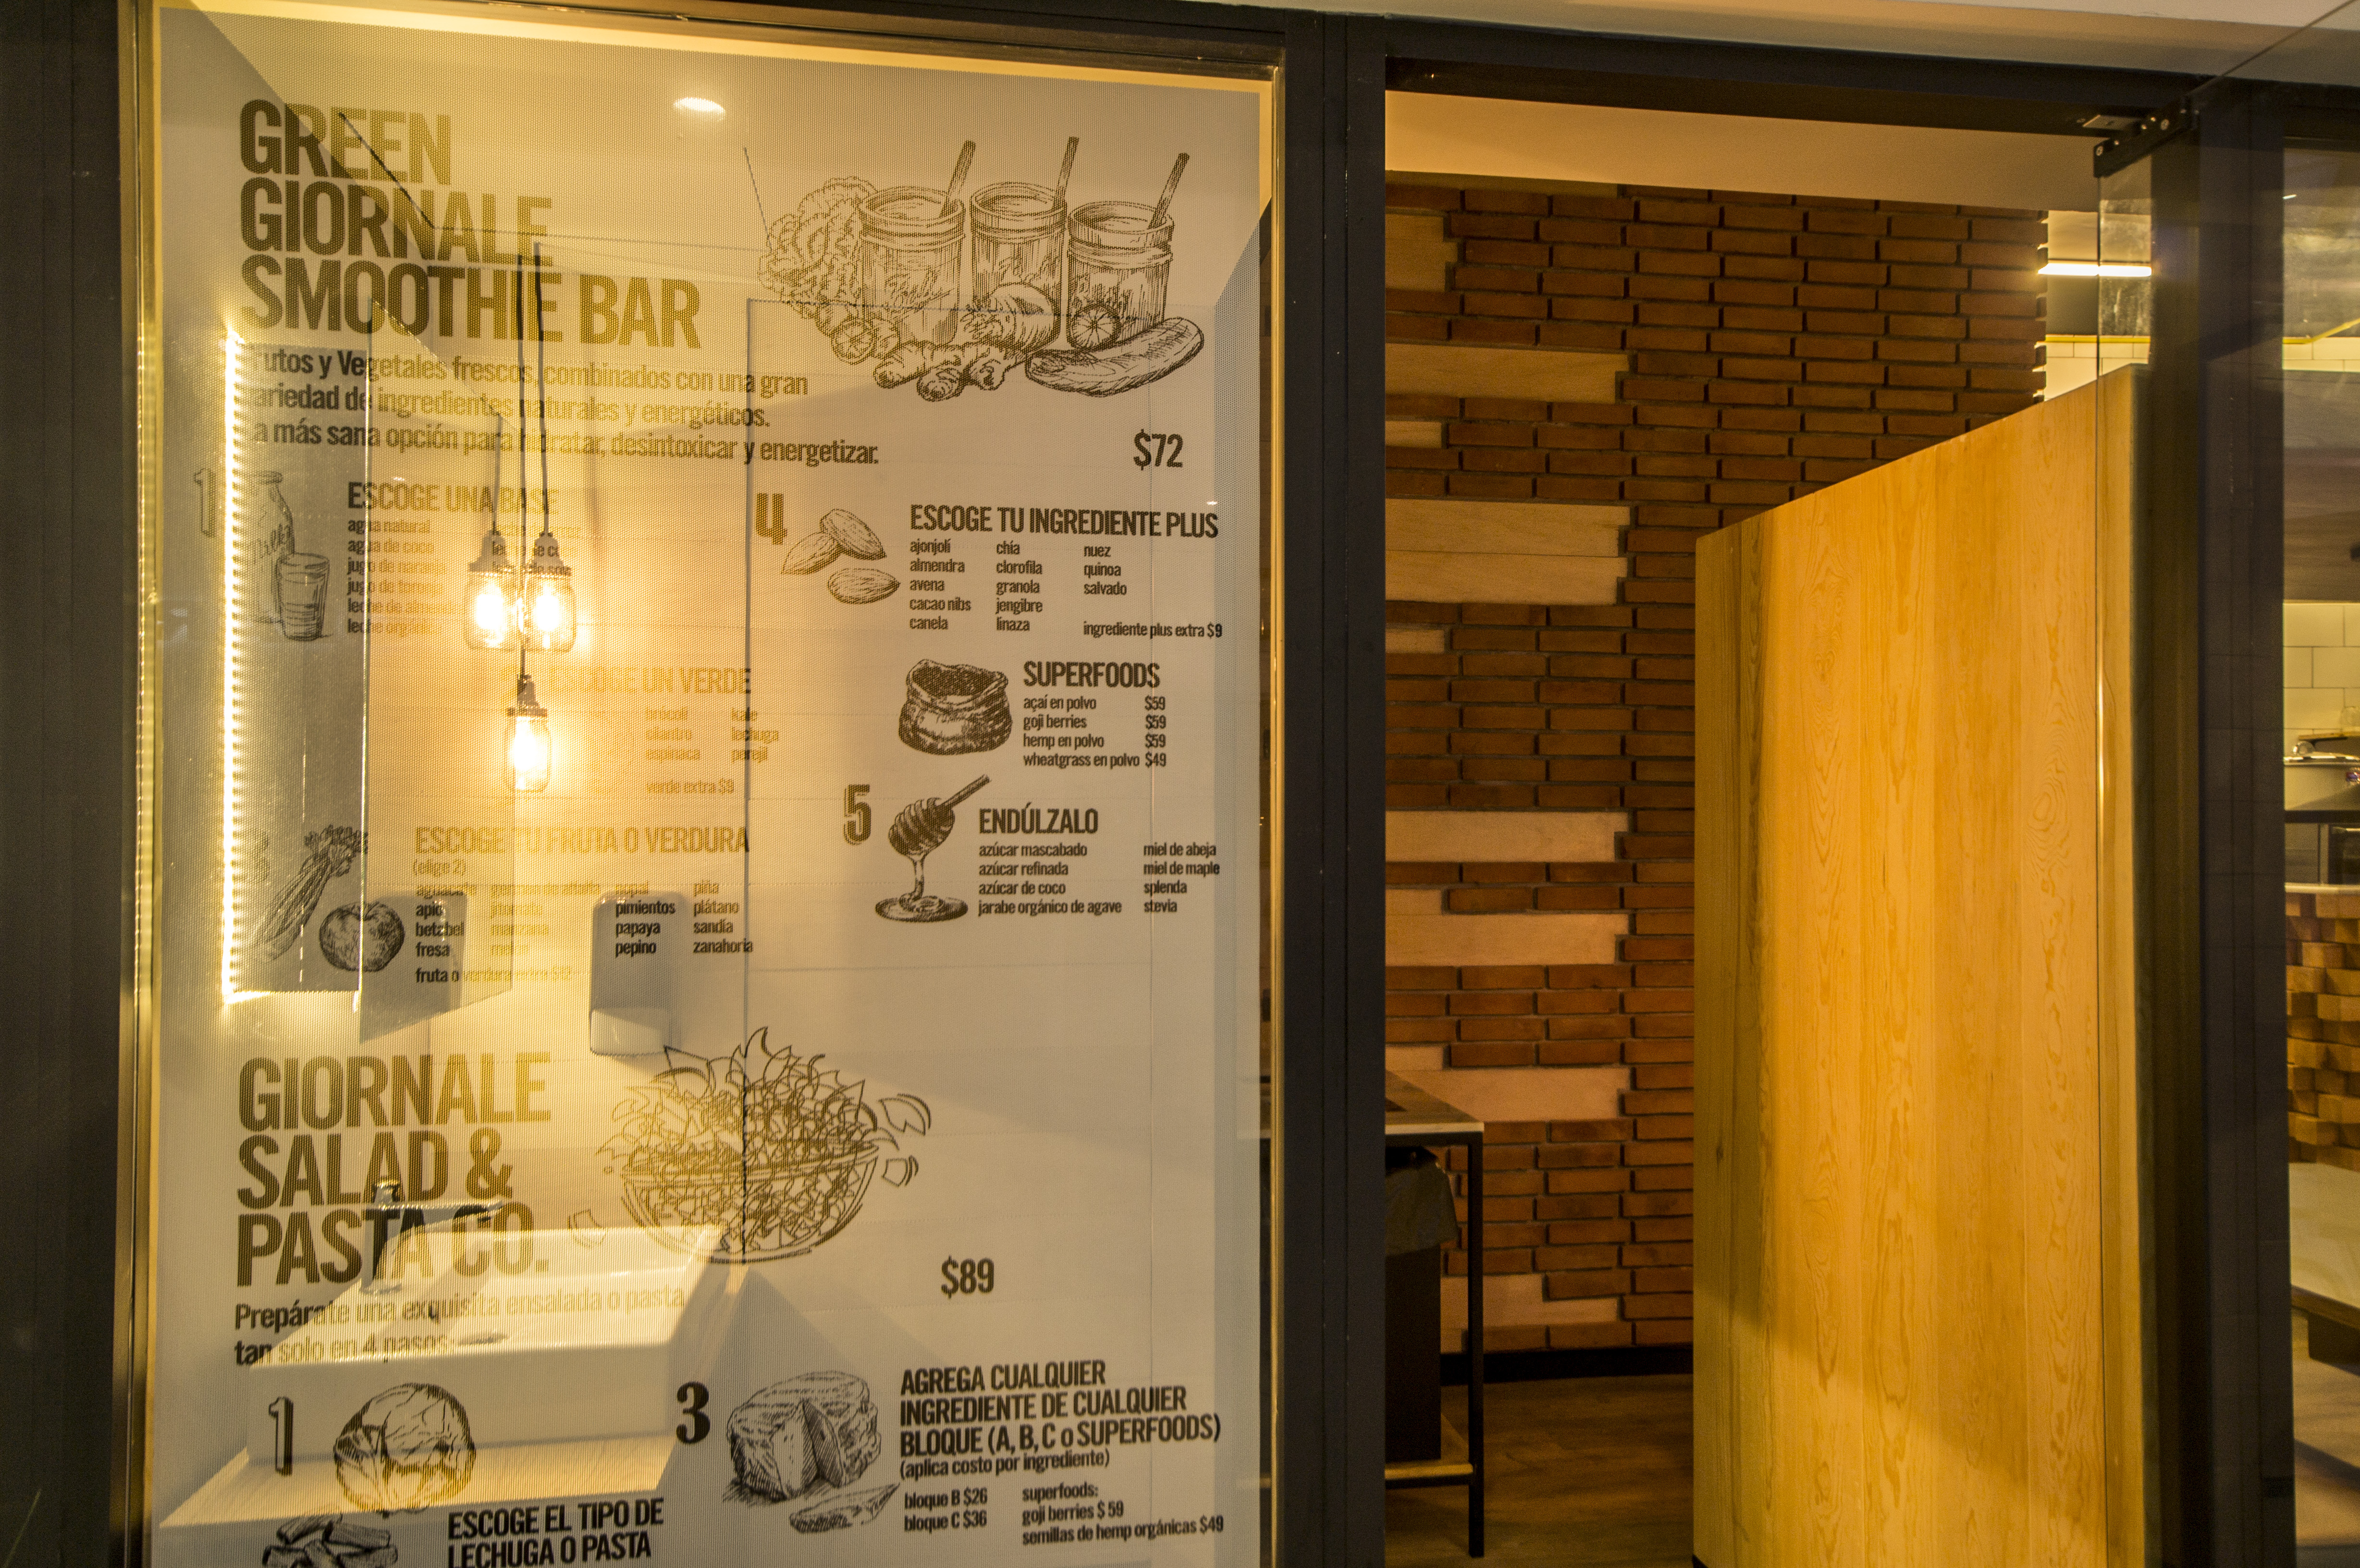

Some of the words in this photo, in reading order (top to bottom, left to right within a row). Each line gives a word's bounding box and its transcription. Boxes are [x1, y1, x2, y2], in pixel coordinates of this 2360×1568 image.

[240, 99, 451, 185] GREEN
[240, 177, 553, 267] GIORNALE
[241, 254, 563, 342] SMOOTHIE
[579, 273, 701, 349] BAR
[319, 355, 332, 380] y
[337, 350, 447, 382] Vegetales
[544, 362, 668, 390] combinados
[676, 371, 713, 392] con
[720, 374, 756, 393] una
[761, 375, 808, 399] gran
[345, 386, 372, 412] de
[378, 388, 513, 419] ingredientes
[273, 417, 321, 444] más
[327, 425, 381, 447] sana
[386, 423, 458, 453] opción
[464, 428, 513, 455] para
[611, 432, 738, 460] desintoxicar
[744, 440, 755, 466] y
[760, 439, 879, 467] energetizar.
[1133, 429, 1183, 471] $72
[193, 467, 217, 539] 1
[348, 482, 440, 512] ESCOGE
[445, 485, 494, 514] UNA
[500, 487, 559, 514] BASE
[756, 493, 787, 545] 4
[910, 504, 993, 532] ESCOGE
[997, 506, 1024, 533] TU
[1030, 508, 1162, 536] INGREDIENTE
[1166, 512, 1219, 539] PLUS
[910, 538, 951, 556] ajonjolí
[996, 540, 1020, 555] chía
[1084, 545, 1111, 557] nuez
[910, 558, 965, 573] almendra
[996, 560, 1043, 575] clorofila
[1084, 562, 1121, 579] quinoa
[910, 580, 945, 592] avena
[996, 579, 1040, 596] granola
[1084, 581, 1127, 596] salvado
[910, 599, 945, 611] cacao
[948, 597, 971, 611] nibs
[996, 597, 1043, 615] jengibre
[910, 615, 948, 630] canela
[996, 617, 1030, 632] linaza
[1083, 621, 1148, 638] ingrediente
[1150, 623, 1172, 640] plus
[1175, 624, 1205, 638] extra
[1207, 622, 1223, 638] $9
[642, 666, 674, 695] UN
[678, 667, 751, 695] VERDE
[1023, 660, 1161, 688] SUPERFOODS
[1023, 694, 1047, 712] açaí
[1050, 698, 1064, 710] en
[1067, 696, 1097, 712] polvo
[1145, 695, 1166, 711] $59
[1023, 714, 1044, 731] goji
[1046, 714, 1087, 729] berries
[1145, 713, 1167, 731] $59
[1023, 733, 1055, 749] hemp
[1058, 736, 1071, 747] en
[1074, 734, 1105, 750] polvo
[1145, 733, 1166, 749] $59
[1023, 752, 1091, 769] wheatgrass
[1094, 755, 1107, 767] en
[1110, 753, 1140, 770] polvo
[1145, 752, 1167, 768] $49
[843, 784, 872, 846] 5
[979, 802, 1099, 834] ENDÚLZALO
[415, 827, 506, 855] ESCOGE
[547, 826, 618, 854] FRUTA
[623, 826, 639, 854] O
[644, 826, 750, 854] VERDURA
[979, 842, 1019, 858] azúcar
[1020, 842, 1088, 857] mascabado
[1143, 842, 1167, 857] miel
[1169, 843, 1183, 857] de
[1185, 842, 1217, 859] abeja
[979, 861, 1019, 877] azúcar
[1020, 861, 1069, 876] refinada
[1143, 861, 1167, 876] miel
[1169, 862, 1183, 876] de
[1185, 861, 1220, 879] maple
[979, 880, 1019, 895] azúcar
[1021, 881, 1035, 895] de
[1038, 882, 1066, 895] coco
[1144, 880, 1187, 897] splenda
[615, 900, 676, 919] pimientos
[978, 899, 1016, 917] jarabe
[1018, 898, 1068, 917] orgánico
[1070, 899, 1085, 914] de
[1087, 901, 1122, 917] agave
[1144, 898, 1177, 914] stevia
[615, 922, 661, 938] papaya
[693, 920, 734, 935] sandía
[415, 942, 450, 957] fresa
[615, 940, 657, 959] pepino
[692, 939, 753, 956] zanahoria
[415, 967, 448, 983] fruta
[239, 1051, 551, 1133] GIORNALE
[237, 1130, 449, 1211] SALAD
[465, 1127, 514, 1200] &
[237, 1206, 434, 1288] PASTA
[452, 1200, 550, 1278] CO.
[941, 1254, 995, 1299] $89
[235, 1298, 351, 1333] Prepárate
[356, 1299, 398, 1322] una
[401, 1292, 500, 1324] exquisita
[506, 1286, 603, 1316] ensalada
[625, 1284, 684, 1313] pasta
[234, 1339, 272, 1366] tan
[900, 1365, 985, 1395] AGREGA
[991, 1359, 1106, 1391] CUALQUIER
[676, 1381, 711, 1445] 3
[900, 1392, 1036, 1427] INGREDIENTE
[1042, 1391, 1068, 1418] DE
[1073, 1385, 1187, 1416] CUALQUIER
[268, 1395, 294, 1476] 1
[900, 1426, 983, 1458] BLOQUE
[988, 1425, 1015, 1455] (A,
[1019, 1423, 1039, 1453] B,
[1042, 1422, 1057, 1449] C
[1061, 1427, 1074, 1448] o
[1077, 1412, 1222, 1446] SUPERFOODS)
[900, 1457, 949, 1481] (aplica
[951, 1456, 992, 1476] costo
[995, 1457, 1020, 1477] por
[1023, 1448, 1110, 1473] ingrediente)
[904, 1491, 948, 1512] bloque
[951, 1489, 960, 1507] B
[963, 1487, 988, 1507] $26
[1022, 1481, 1099, 1505] superfoods:
[448, 1506, 540, 1539] ESCOGE
[545, 1504, 572, 1532] EL
[578, 1499, 629, 1531] TIPO
[635, 1496, 664, 1527] DE
[904, 1513, 948, 1534] bloque
[950, 1512, 960, 1529] C
[963, 1509, 988, 1530] $36
[1022, 1507, 1046, 1528] goji
[1048, 1503, 1094, 1521] berries
[1022, 1526, 1075, 1545] semillas
[1077, 1524, 1094, 1541] de
[1095, 1522, 1132, 1542] hemp
[1133, 1518, 1197, 1539] orgánicas
[1200, 1514, 1224, 1534] $49
[448, 1537, 554, 1568] LECHUGA
[560, 1534, 577, 1564] O
[582, 1531, 652, 1563] PASTA
